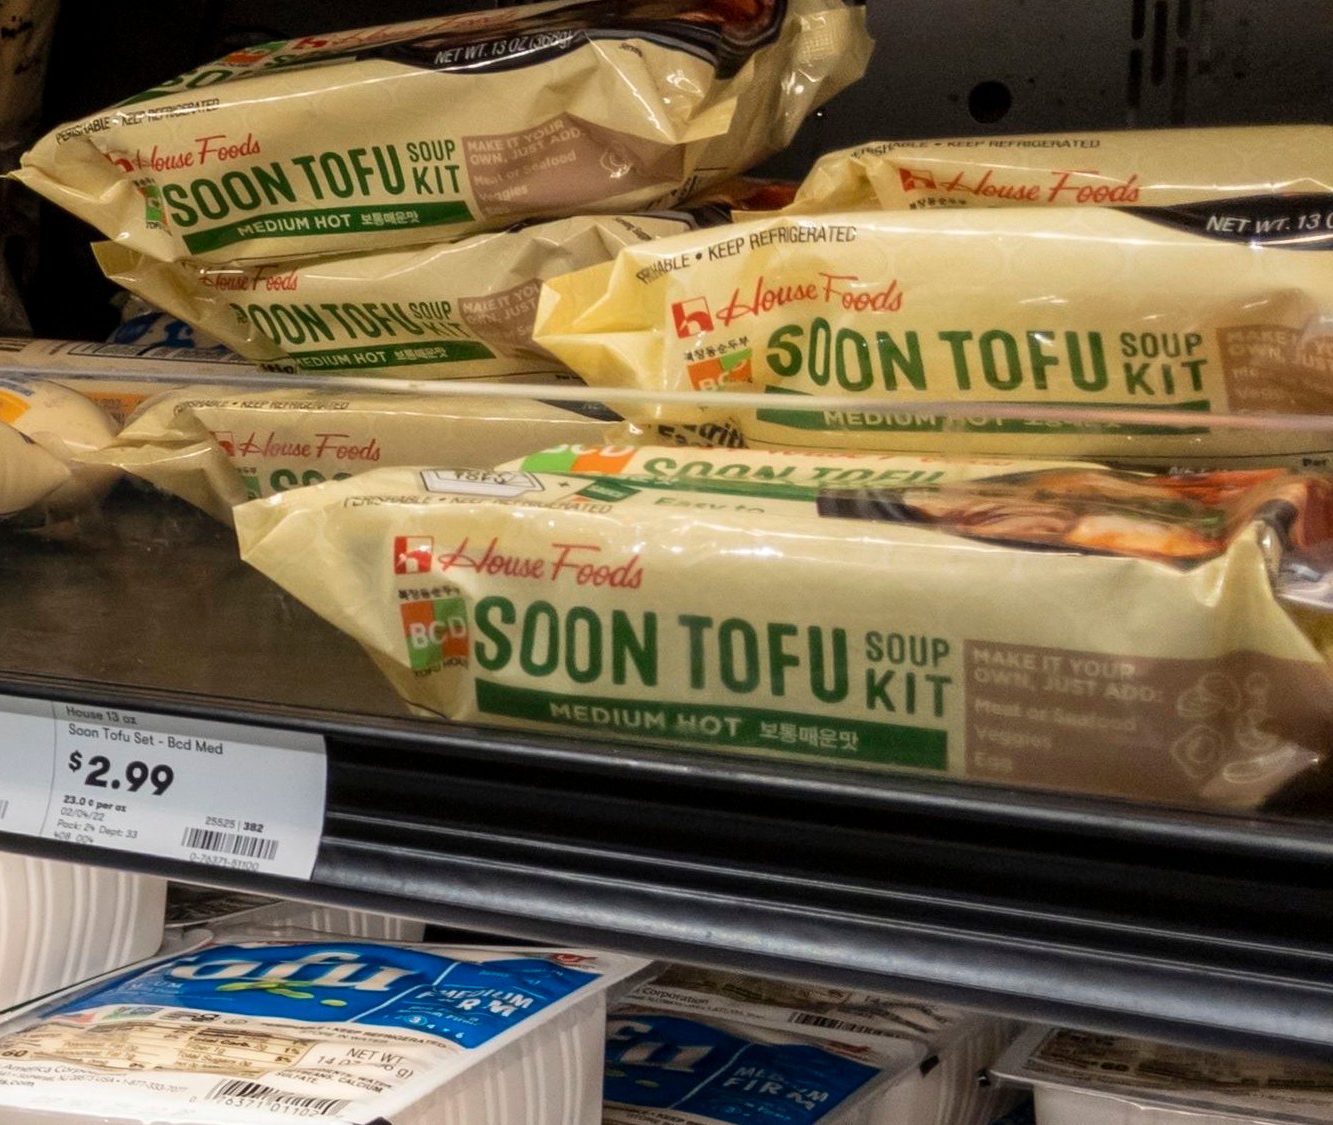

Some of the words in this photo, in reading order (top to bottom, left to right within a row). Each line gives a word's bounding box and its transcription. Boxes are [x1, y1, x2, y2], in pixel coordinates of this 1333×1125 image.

[134, 145, 194, 172] House
[195, 133, 261, 164] Foods
[406, 139, 456, 163] SOUP
[162, 162, 297, 227] SOON
[292, 142, 406, 199] TOFU
[413, 164, 460, 195] KIT
[941, 171, 1040, 204] House
[1047, 171, 1140, 205] Foods
[238, 217, 309, 236] MEDIUM
[314, 214, 350, 230] HOT
[1206, 215, 1251, 233] NET
[1255, 217, 1291, 233] WT.
[1298, 213, 1321, 229] 13
[708, 237, 745, 261] KEEP
[750, 225, 857, 252] REFRIGERATED
[250, 265, 299, 292] Foods
[409, 300, 452, 322] SOUP
[716, 276, 818, 327] House
[818, 272, 904, 313] Foods
[321, 302, 425, 339] TOFU
[356, 350, 387, 365] HOT
[766, 316, 926, 392] SOON
[939, 331, 1110, 393] TOFU
[1122, 331, 1203, 360] SOUP
[1124, 359, 1208, 395] KIT
[238, 431, 311, 459] House
[314, 432, 381, 462] Foods
[438, 536, 544, 580] House
[551, 542, 644, 590] Foods
[408, 614, 467, 650] BCD
[474, 594, 659, 688] SOON
[678, 614, 849, 703] TOFU
[866, 630, 950, 667] SOUP
[973, 649, 1034, 670] MAKE
[1042, 656, 1062, 671] IT
[1069, 658, 1136, 679] YOUR
[866, 667, 952, 718] KIT
[1042, 675, 1097, 696] JUST
[66, 706, 103, 722] House
[106, 710, 120, 723] 13
[123, 714, 137, 725] oz
[550, 702, 666, 729] MEDIUM
[677, 713, 742, 737] HOT
[68, 723, 99, 738] Soon
[102, 728, 130, 743] Tofu
[134, 732, 154, 746] Set
[168, 737, 192, 751] Bcd
[195, 741, 223, 755] Med
[759, 720, 859, 752] 보통매운맛
[68, 750, 174, 796] $2.99
[63, 795, 86, 806] 23.0
[96, 802, 113, 812] per
[115, 804, 127, 813] oz
[243, 821, 264, 833] 382
[346, 1047, 375, 1061] NET
